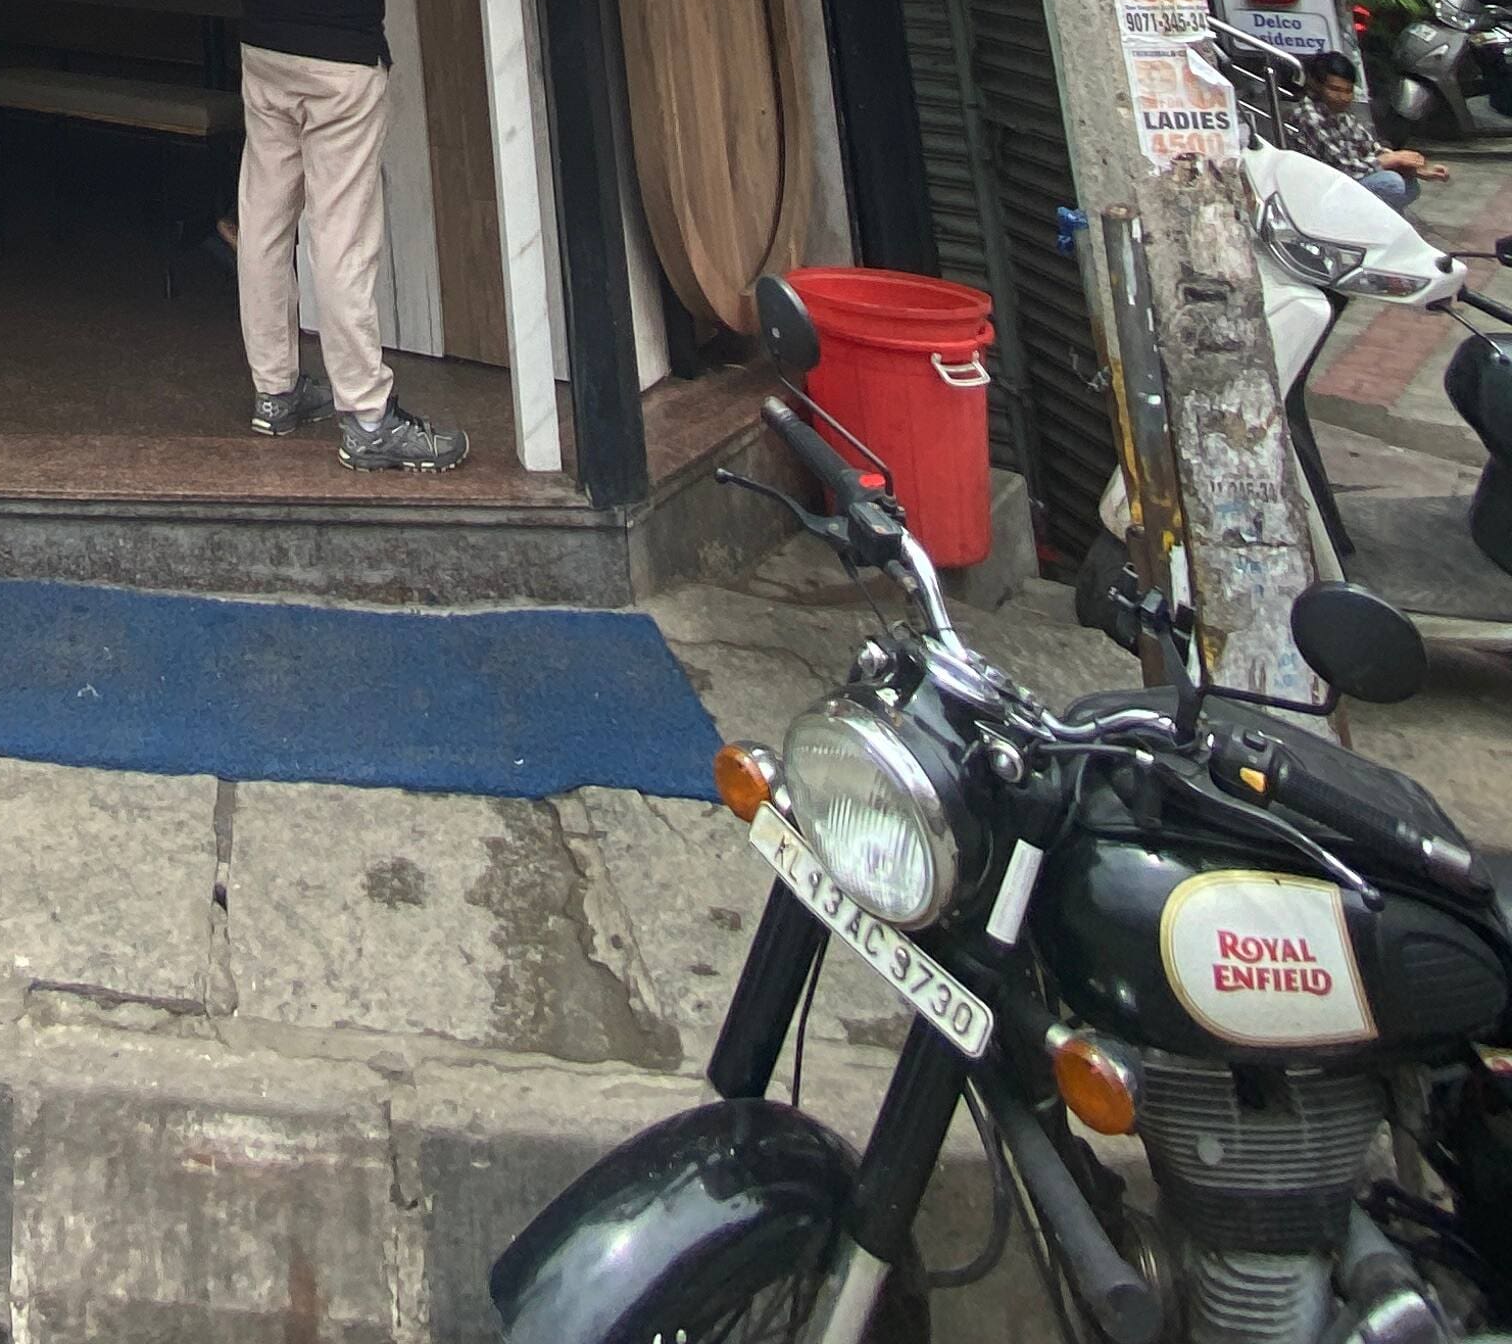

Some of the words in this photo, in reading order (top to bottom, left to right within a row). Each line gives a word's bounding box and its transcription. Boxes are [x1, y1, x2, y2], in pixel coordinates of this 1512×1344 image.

[1253, 14, 1302, 30] Delco
[1256, 32, 1326, 52] sidency
[1143, 111, 1231, 130] LADIES
[1217, 929, 1317, 964] ROYAL
[1213, 963, 1333, 996] ENFIELD
